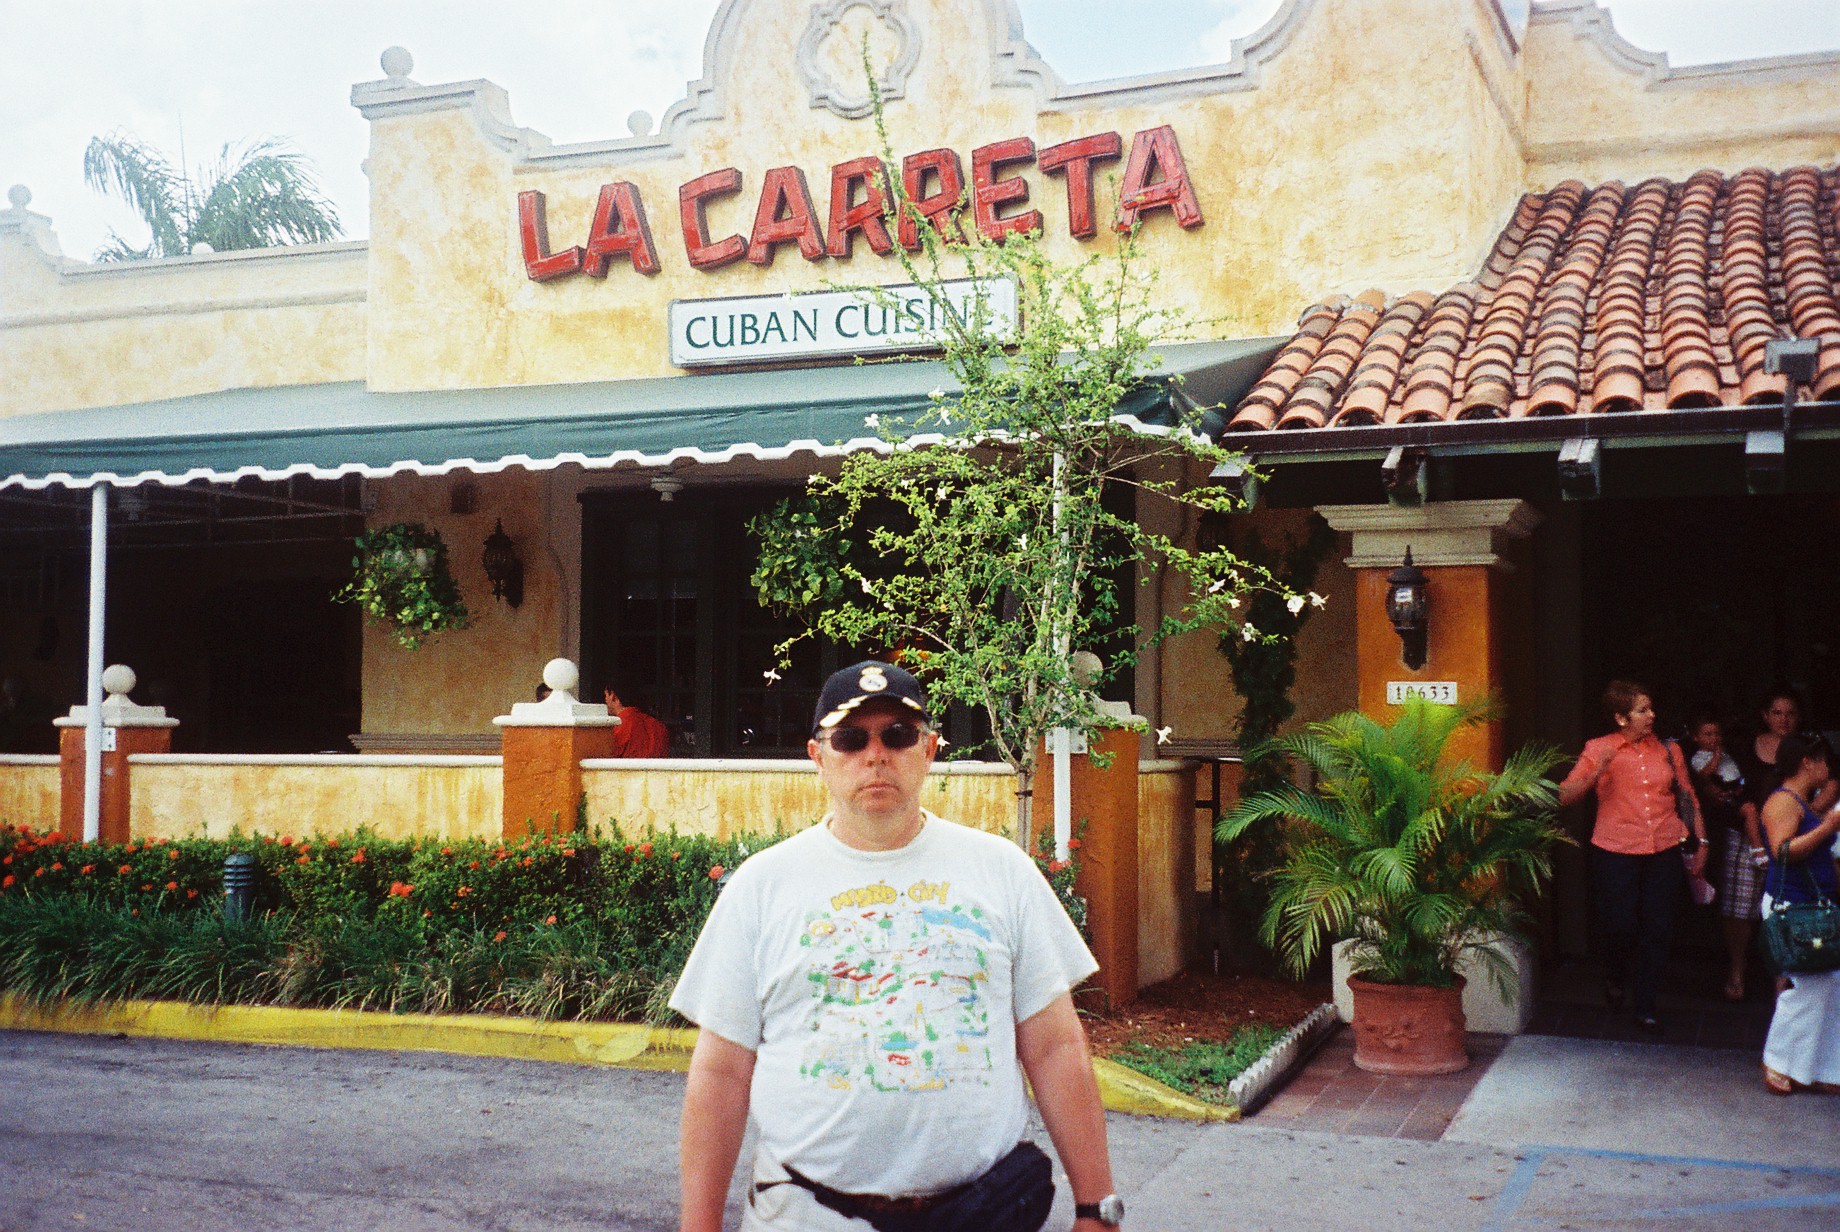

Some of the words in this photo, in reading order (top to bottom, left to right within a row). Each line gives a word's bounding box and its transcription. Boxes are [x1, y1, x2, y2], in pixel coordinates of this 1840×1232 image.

[518, 181, 661, 282] LA
[679, 124, 1205, 271] CARRETA
[685, 308, 818, 349] CUBAN
